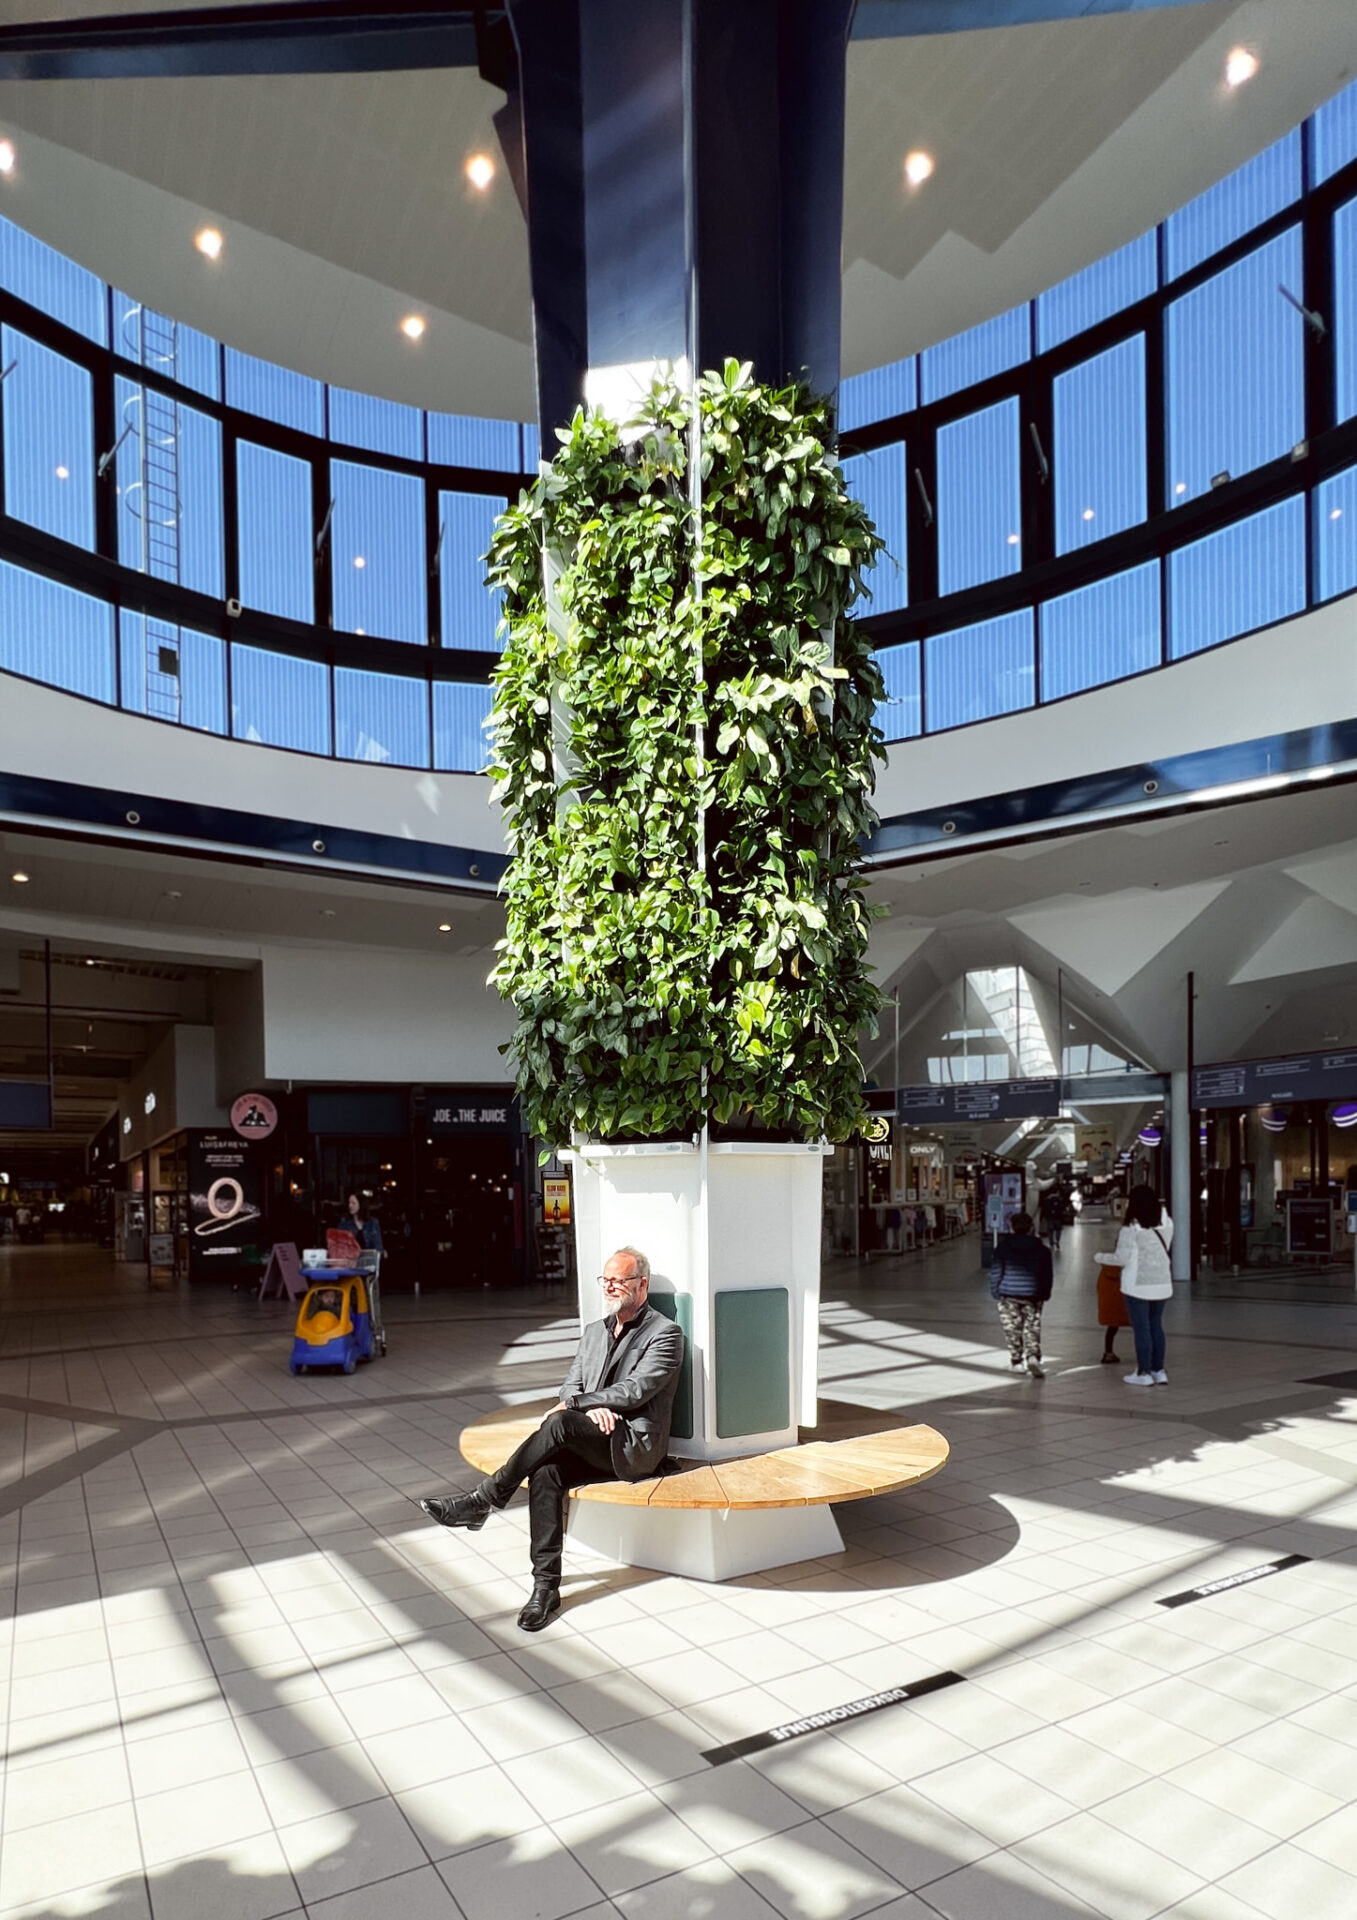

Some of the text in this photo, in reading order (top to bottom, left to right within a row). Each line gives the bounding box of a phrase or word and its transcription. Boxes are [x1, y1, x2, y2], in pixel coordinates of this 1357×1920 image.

[433, 1109, 451, 1122] JOE
[458, 1109, 476, 1122] THE
[479, 1109, 507, 1122] JUICE
[910, 1146, 936, 1154] ONLY
[769, 1688, 909, 1740] DISKRETIONSLINJE
